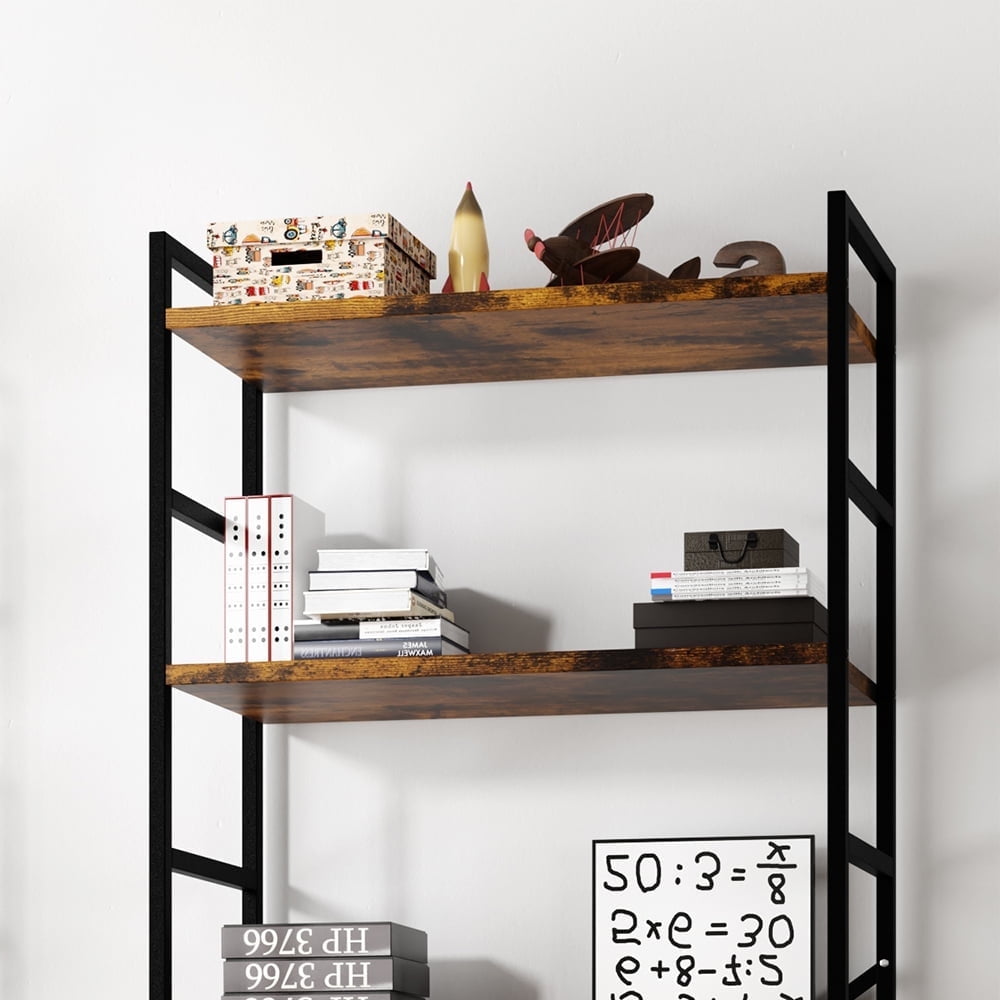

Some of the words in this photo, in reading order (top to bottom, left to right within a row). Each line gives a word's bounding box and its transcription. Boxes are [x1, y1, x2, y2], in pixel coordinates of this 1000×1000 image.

[243, 928, 313, 956] 3766
[322, 927, 369, 954] HP
[245, 962, 315, 990] 3766
[324, 961, 371, 989] HP
